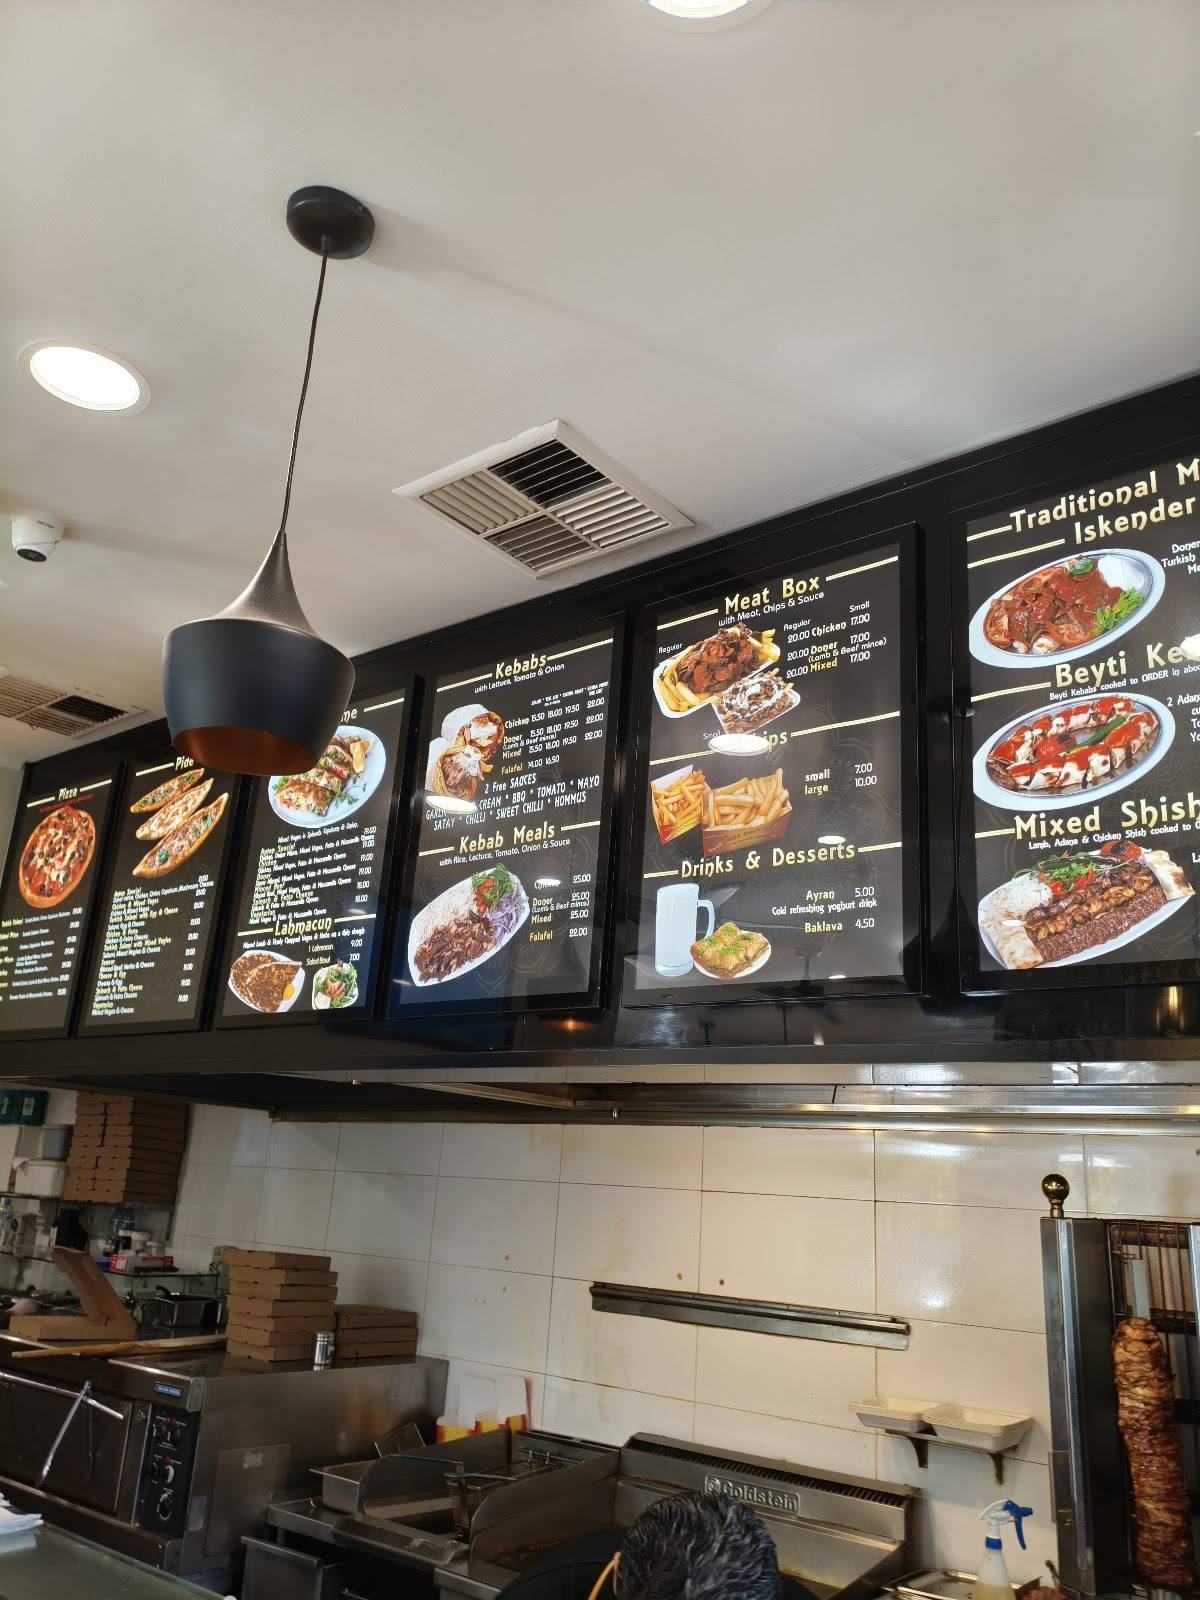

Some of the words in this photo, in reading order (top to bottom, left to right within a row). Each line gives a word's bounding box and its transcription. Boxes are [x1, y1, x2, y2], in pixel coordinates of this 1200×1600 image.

[1009, 470, 1158, 532] Traditional
[1074, 496, 1196, 544] Iskender
[1161, 552, 1196, 568] Turkish
[724, 588, 770, 615] Meat
[782, 576, 820, 599] Box
[718, 615, 735, 627] with
[737, 608, 761, 622] Meat,
[763, 602, 786, 615] Chips
[788, 598, 796, 607] &
[798, 592, 825, 605] Sauce
[783, 619, 811, 632] Regular
[849, 600, 870, 613] Small
[787, 630, 810, 644] 20.00
[811, 621, 847, 637] Chicken
[850, 613, 870, 626] 17.00
[658, 643, 683, 654] Regular
[787, 648, 809, 661] 20.00
[810, 641, 838, 655] Doner
[850, 632, 870, 644] 17.00
[808, 652, 831, 663] (Lamb
[840, 644, 860, 655] Beef
[861, 637, 887, 650] mince)
[495, 654, 547, 680] Kebabs
[786, 665, 809, 679] 20.00
[810, 657, 838, 672] Mixed
[850, 651, 870, 663] 17.00
[1055, 650, 1127, 688] Beyti
[474, 685, 487, 694] with
[513, 672, 537, 683] Tomato
[545, 663, 565, 674] Onion
[1049, 690, 1068, 701] Beyti
[1071, 686, 1097, 697] Kebabs
[1101, 679, 1127, 691] cooked
[1142, 669, 1169, 682] ORDER
[1172, 668, 1180, 677] in
[505, 717, 529, 729] Chicken
[547, 708, 563, 719] 18.00
[565, 704, 580, 714] 19.50
[587, 697, 605, 709] 22.00
[1167, 697, 1173, 707] 2
[503, 735, 523, 745] Doner
[563, 719, 579, 730] 19.50
[585, 713, 604, 725] 22.00
[502, 748, 522, 760] Mixed
[562, 736, 577, 746] 19.50
[584, 730, 603, 741] 22.00
[175, 756, 194, 771] Pide
[501, 762, 523, 775] Falafel
[805, 769, 830, 782] small
[854, 762, 873, 773] 7.00
[58, 787, 78, 801] Pizza
[479, 796, 502, 810] CREAM
[512, 791, 526, 804] BBQ
[537, 782, 566, 798] TOMATO
[577, 775, 600, 791] MAYO
[484, 783, 489, 794] 2
[492, 781, 507, 793] Free
[510, 773, 537, 789] SAUCES
[805, 783, 829, 796] large
[854, 776, 877, 787] 10.00
[433, 817, 456, 831] SATAY
[465, 811, 486, 825] CHILLI
[495, 805, 520, 820] SWEET
[522, 799, 544, 814] CHILLI
[554, 791, 587, 808] HOMMUS
[1014, 805, 1100, 840] Mixed
[1121, 792, 1200, 829] Shish
[459, 831, 504, 854] Kebab
[513, 820, 555, 845] Meals
[521, 843, 541, 854] Onion
[542, 841, 549, 849] &
[550, 837, 571, 848] Sauce
[1054, 837, 1078, 848] Adana
[1082, 835, 1089, 844] &
[1093, 832, 1122, 844] Chicken
[1125, 826, 1147, 839] Shish
[1150, 823, 1179, 835] cooked
[1182, 822, 1191, 831] to
[681, 855, 734, 878] Drinks
[746, 851, 761, 870] &
[773, 843, 855, 867] Desserts
[573, 873, 591, 884] 25.00
[532, 897, 553, 907] Doner
[571, 891, 590, 901] 25.00
[806, 890, 835, 902] Ayran
[854, 886, 875, 898] 5.00
[531, 912, 552, 924] Mixed
[570, 909, 589, 920] 25.00
[772, 906, 787, 916] Cold
[790, 903, 825, 915] refreshing
[827, 901, 856, 914] yoghurt
[858, 899, 878, 909] drink
[275, 917, 332, 936] Lahmacun
[529, 930, 553, 942] Falafel
[568, 927, 588, 938] 22.00
[804, 921, 843, 933] Baklava
[855, 918, 875, 929] 4.50
[723, 1480, 798, 1512] Goldstein
